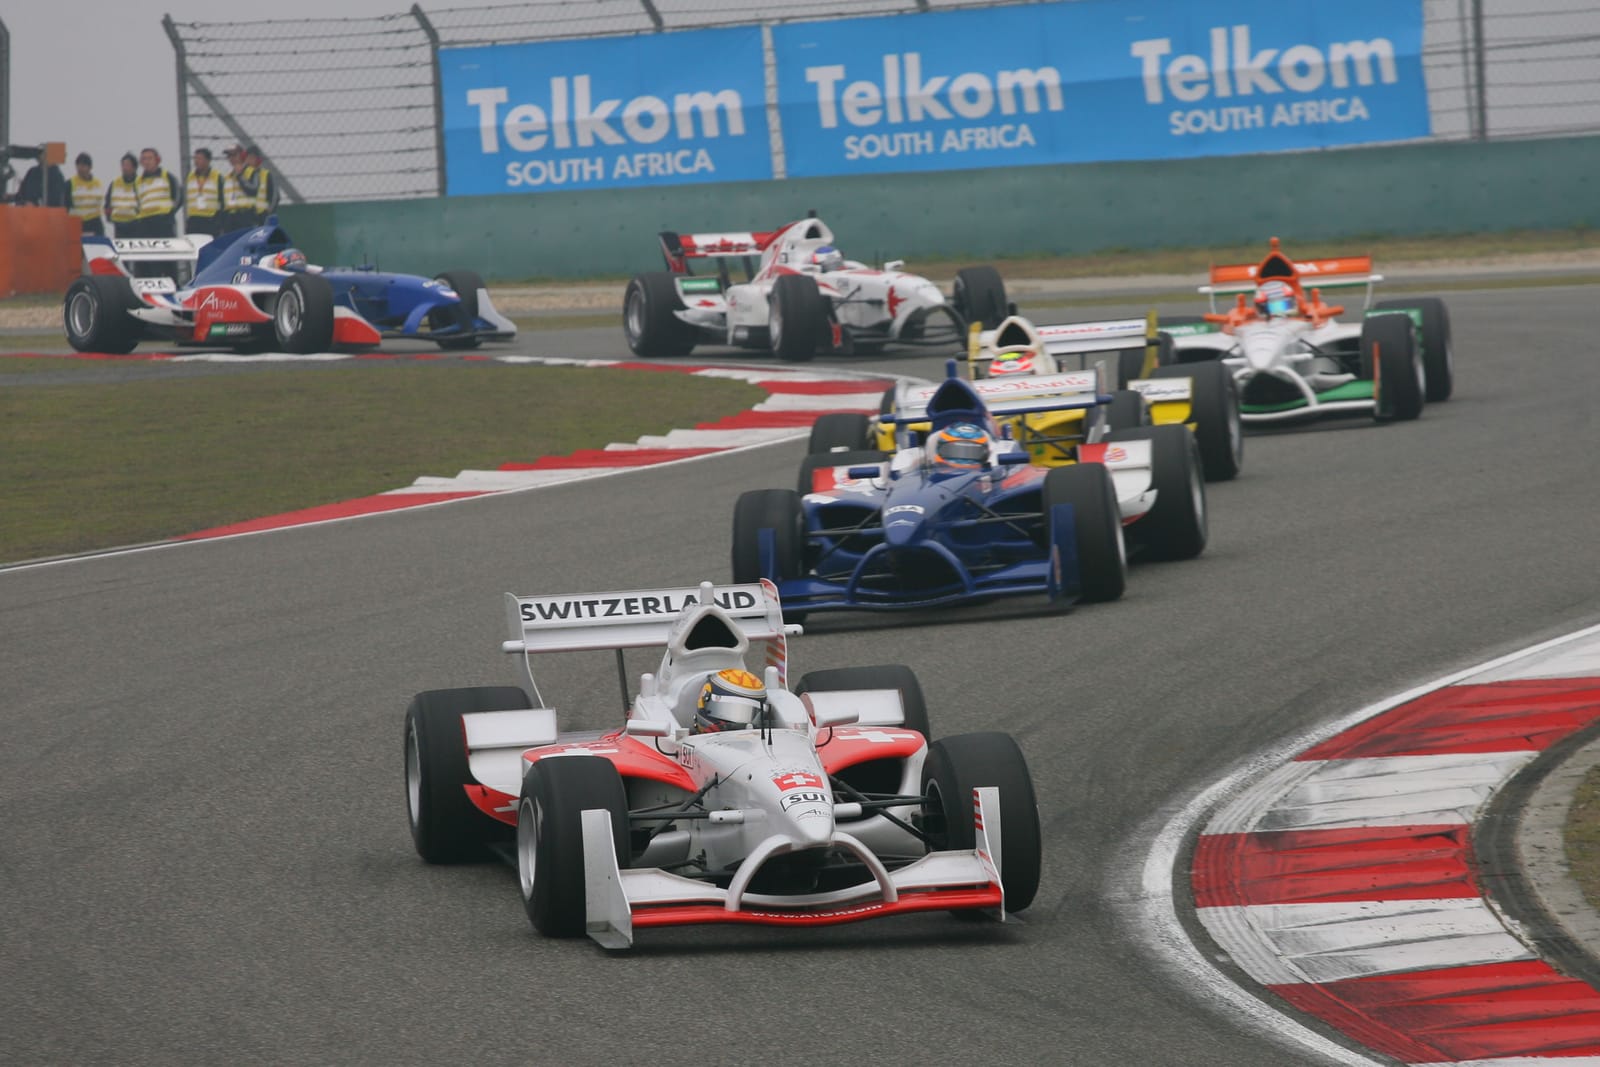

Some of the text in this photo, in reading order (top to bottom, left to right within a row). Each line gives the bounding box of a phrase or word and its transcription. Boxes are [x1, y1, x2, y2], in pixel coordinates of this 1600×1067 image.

[1130, 24, 1398, 104] Telkom
[805, 52, 1064, 129] Telkom
[467, 74, 746, 154] Telkom
[1169, 96, 1370, 136] SOUTH AFRICA
[844, 123, 1036, 161] SOUTH AFRICA
[506, 149, 716, 187] SOUTH AFRICA
[521, 590, 757, 622] SWITZERLAND
[788, 793, 827, 804] SUI
